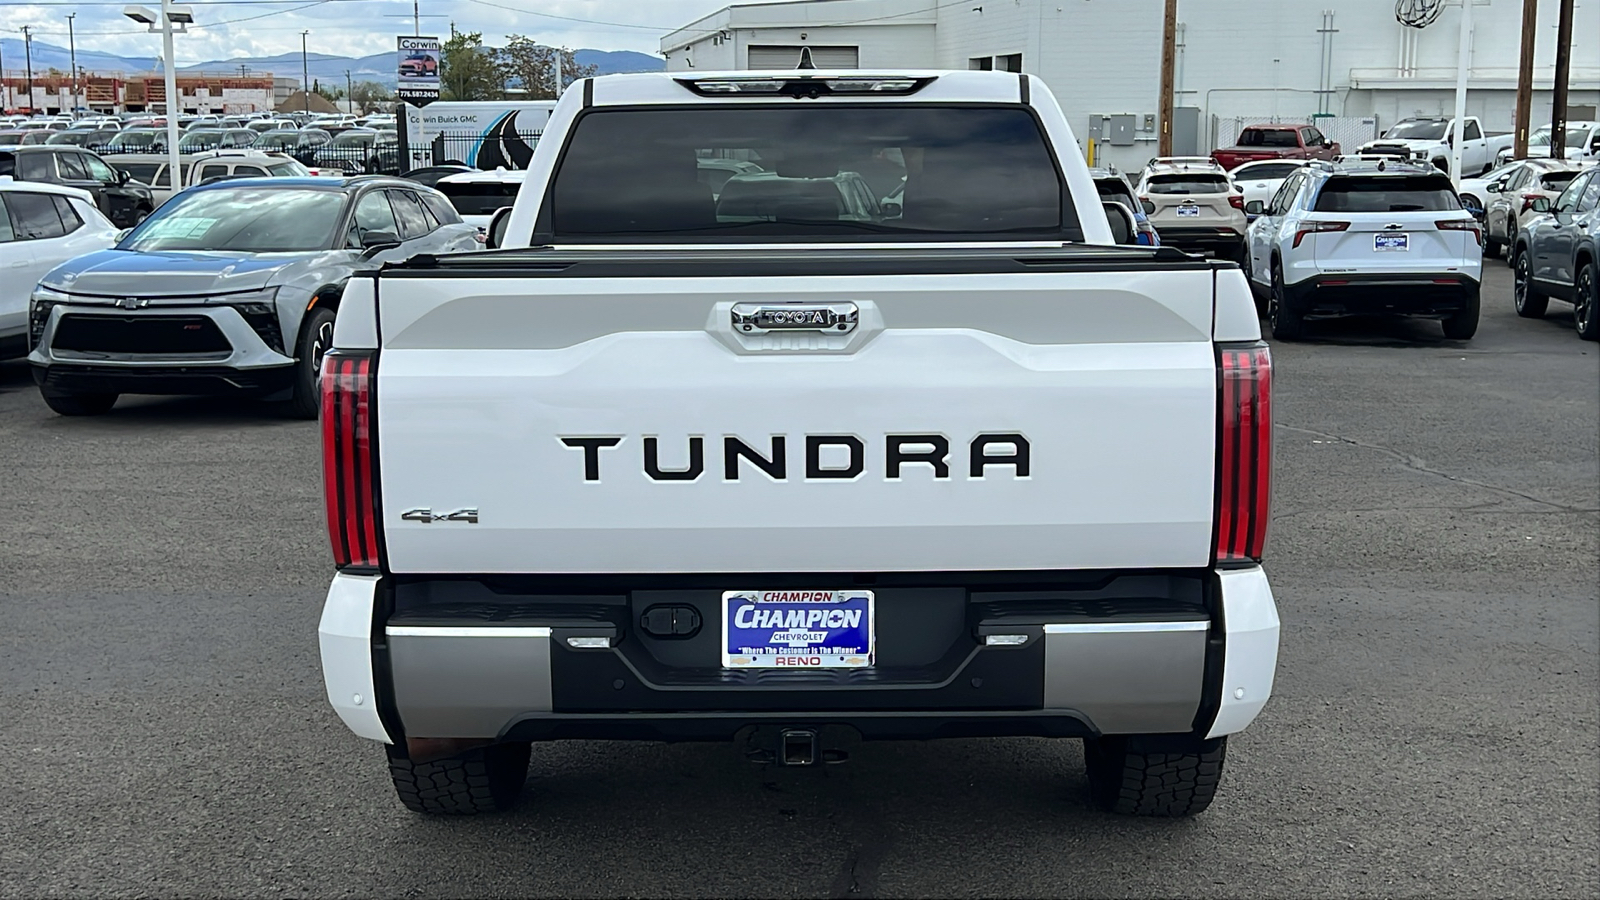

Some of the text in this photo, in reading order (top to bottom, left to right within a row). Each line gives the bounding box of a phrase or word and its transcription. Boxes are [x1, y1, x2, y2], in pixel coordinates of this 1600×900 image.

[402, 39, 438, 49] Corwin
[410, 115, 478, 124] Cowin Buick GMC
[765, 311, 824, 324] TOYOTA
[558, 431, 1032, 483] TUNDRA
[763, 592, 833, 602] CHAMPION
[734, 604, 862, 629] CHAMPION
[773, 633, 823, 641] CHEVROLET
[765, 646, 777, 654] The
[778, 646, 810, 654] Customer
[819, 646, 832, 654] The
[775, 656, 821, 666] RENO
